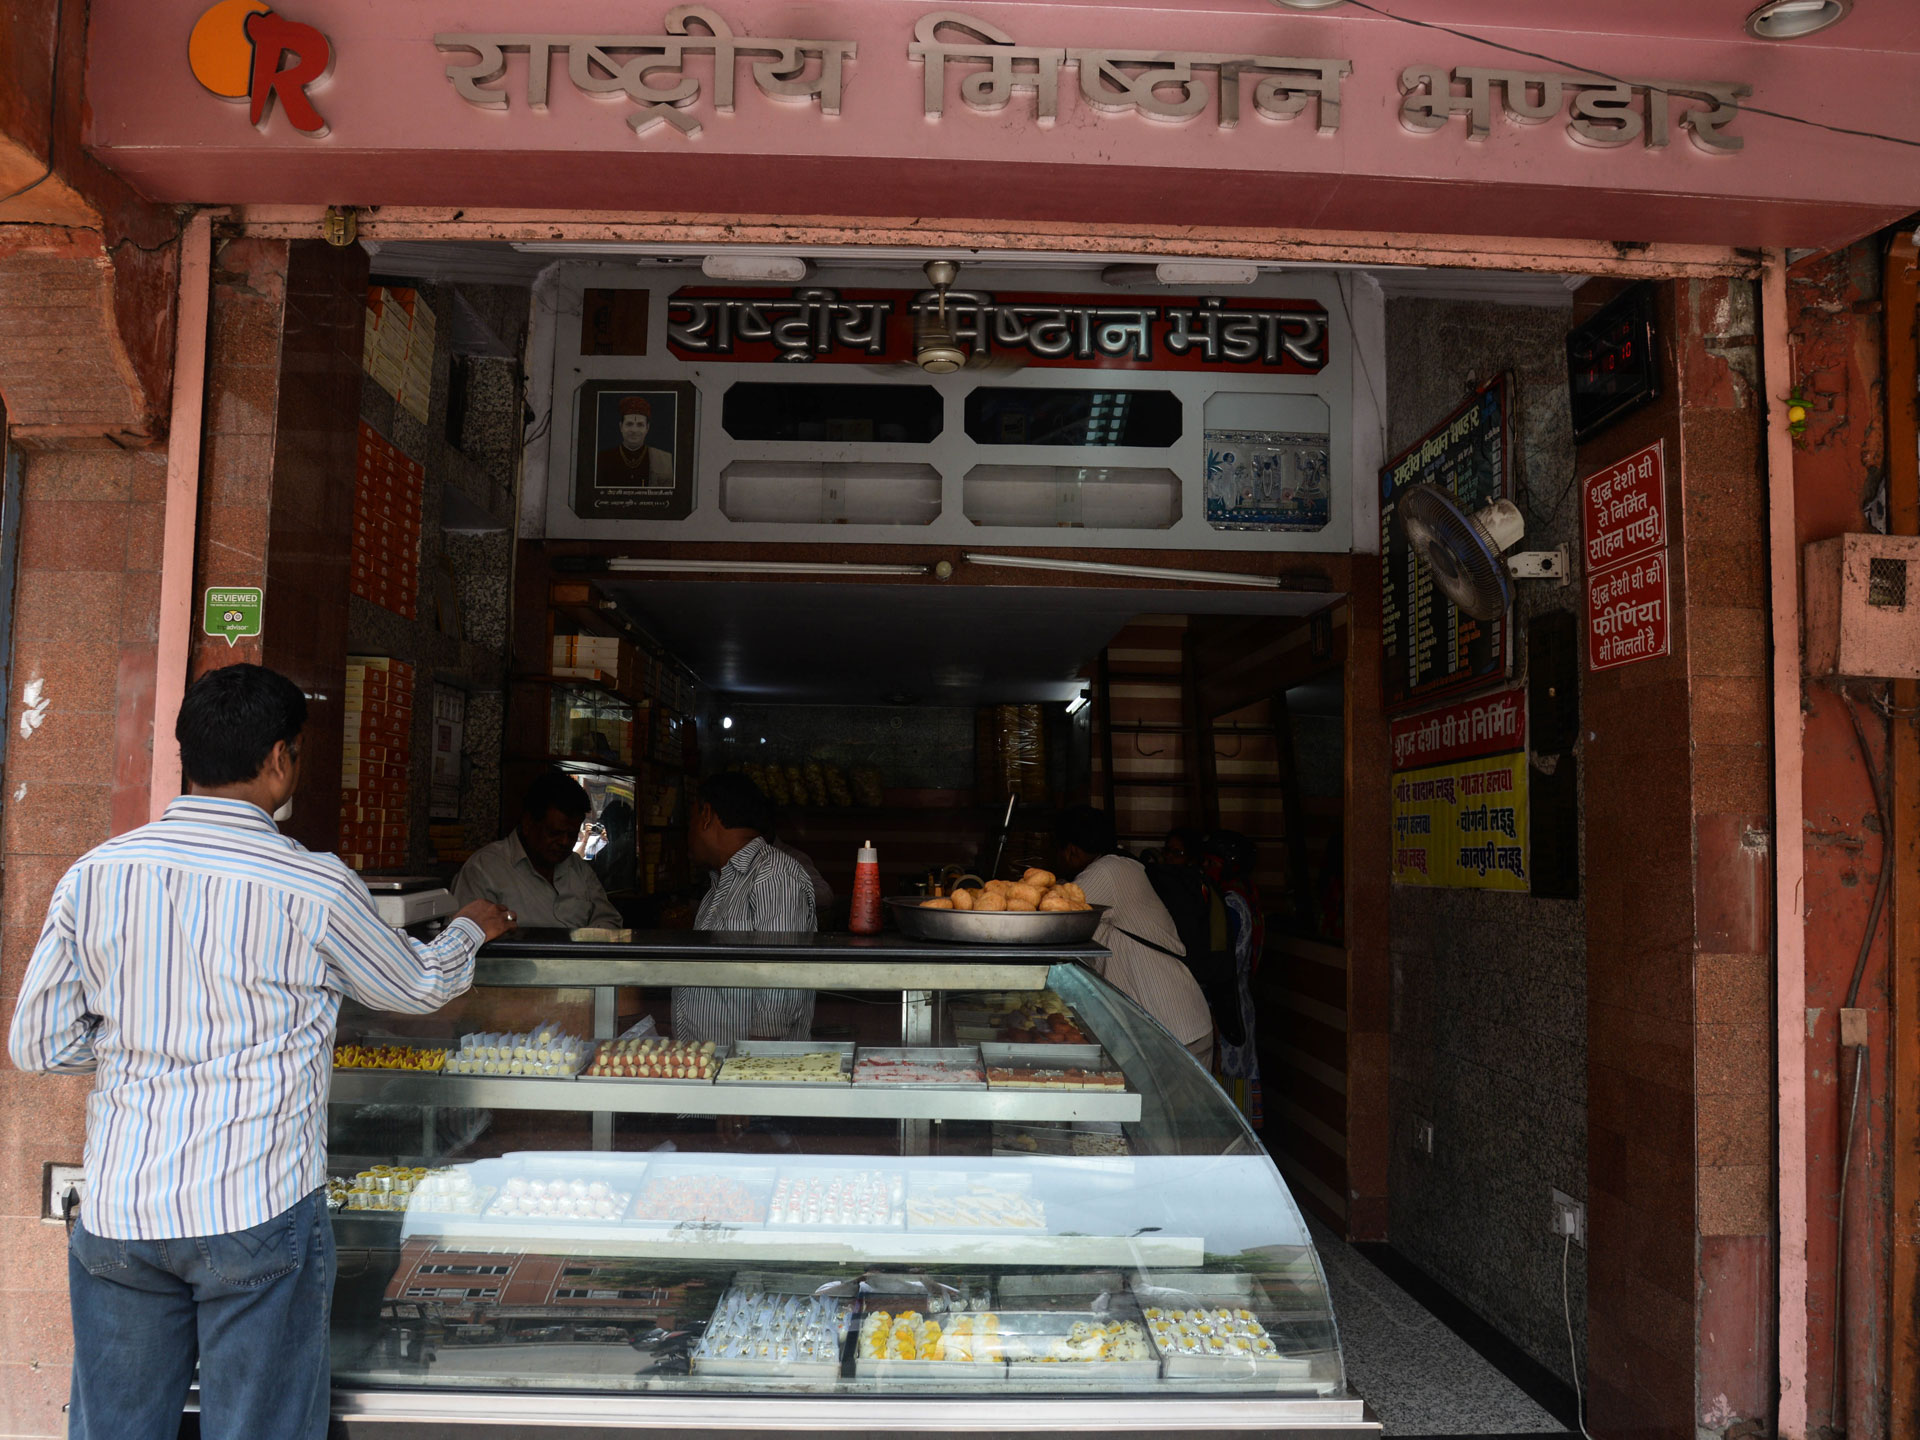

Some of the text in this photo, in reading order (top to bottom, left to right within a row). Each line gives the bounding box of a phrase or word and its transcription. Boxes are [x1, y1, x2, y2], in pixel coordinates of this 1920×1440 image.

[434, 4, 1754, 154] राष्ट्रीय मिष्ठान भण्डार
[1591, 455, 1653, 509] शुद्ध देशी घी
[1598, 489, 1648, 528] से निर्मित
[1589, 505, 1660, 560] सोहन पपड़ी
[211, 594, 258, 602] REVIEWED
[1591, 560, 1661, 610] शुद्ध देशी घी की
[1599, 625, 1655, 662] भी मिलती है
[1417, 719, 1440, 753] देशी
[1442, 715, 1457, 747] घी
[1458, 710, 1471, 745] से
[1471, 701, 1518, 742] निर्मित
[1412, 780, 1435, 801] बादाम
[1460, 768, 1513, 796] गाजर हलवा
[1410, 814, 1431, 834] हलवा
[1460, 841, 1496, 877] कानपुरी
